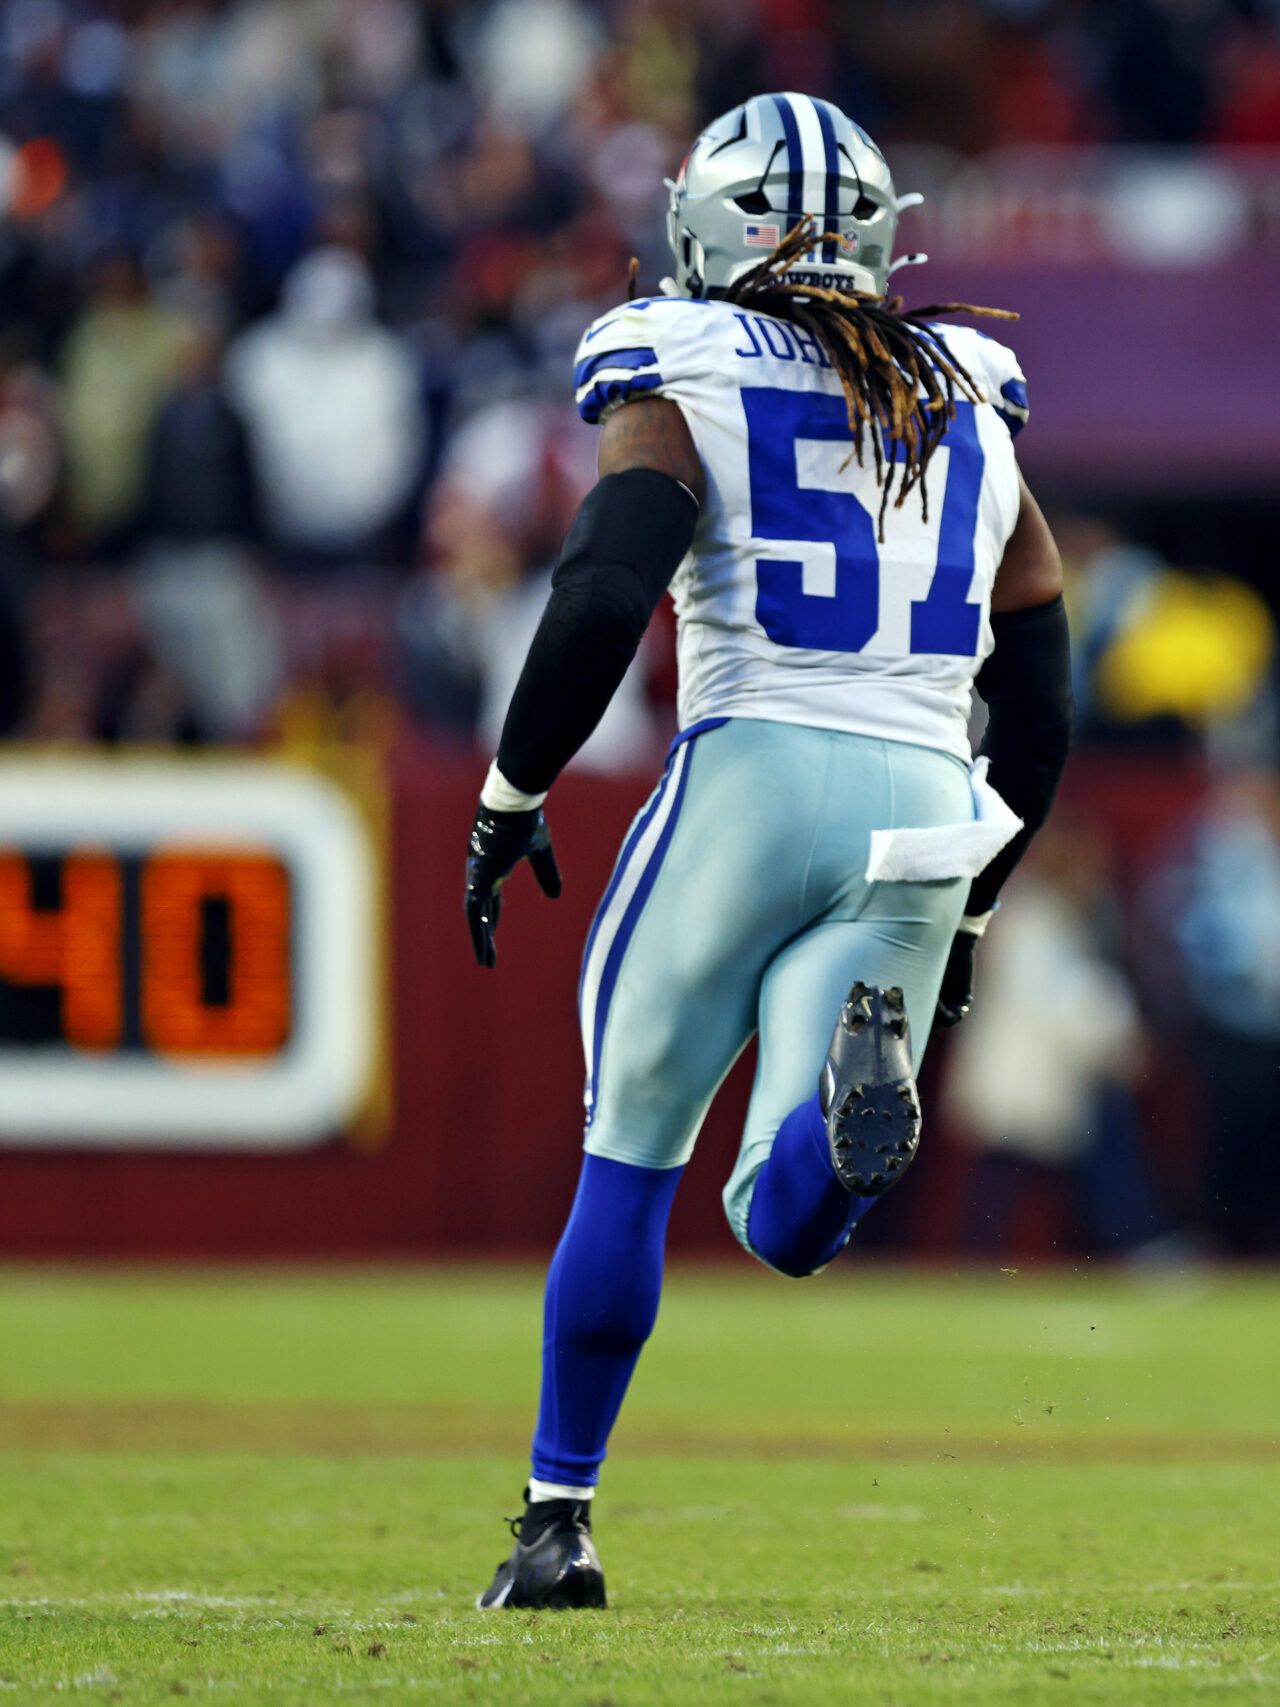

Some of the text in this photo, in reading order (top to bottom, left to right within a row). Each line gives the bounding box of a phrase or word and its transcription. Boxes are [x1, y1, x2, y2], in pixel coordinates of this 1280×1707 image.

[769, 270, 856, 291] OWBOYS
[740, 386, 985, 657] 57
[0, 844, 294, 1066] 40
